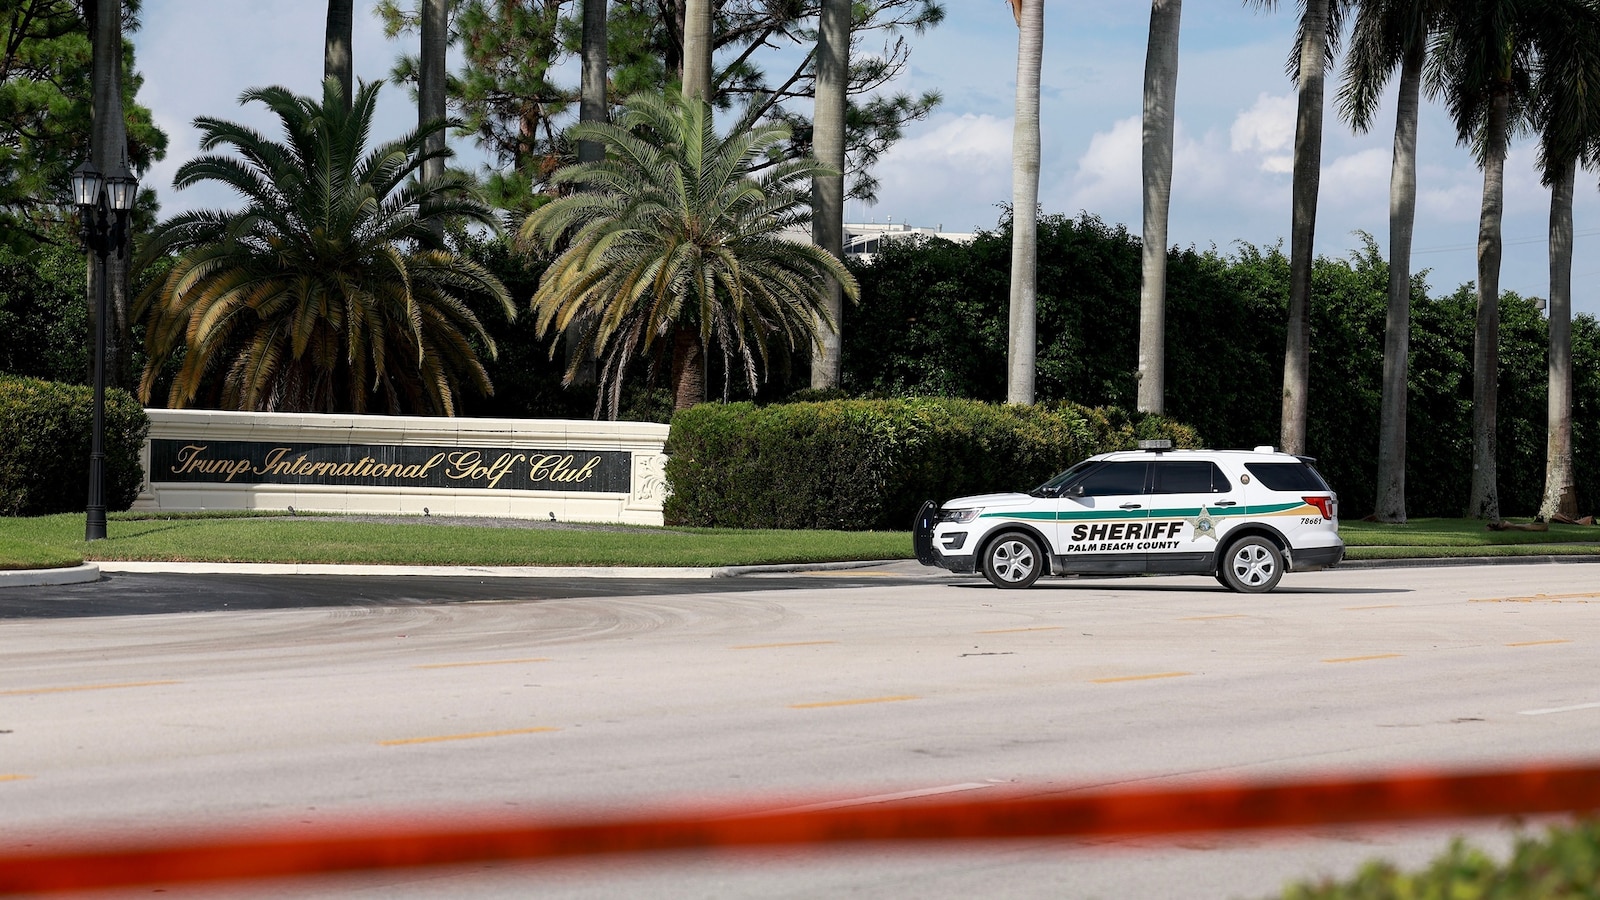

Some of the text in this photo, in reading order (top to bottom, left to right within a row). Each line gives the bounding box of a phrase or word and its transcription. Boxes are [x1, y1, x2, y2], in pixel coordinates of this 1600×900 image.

[171, 444, 601, 488] Trump International Golf Club
[1071, 521, 1184, 541] SHERIFF
[1067, 541, 1180, 552] PALM BEACH COUNTY
